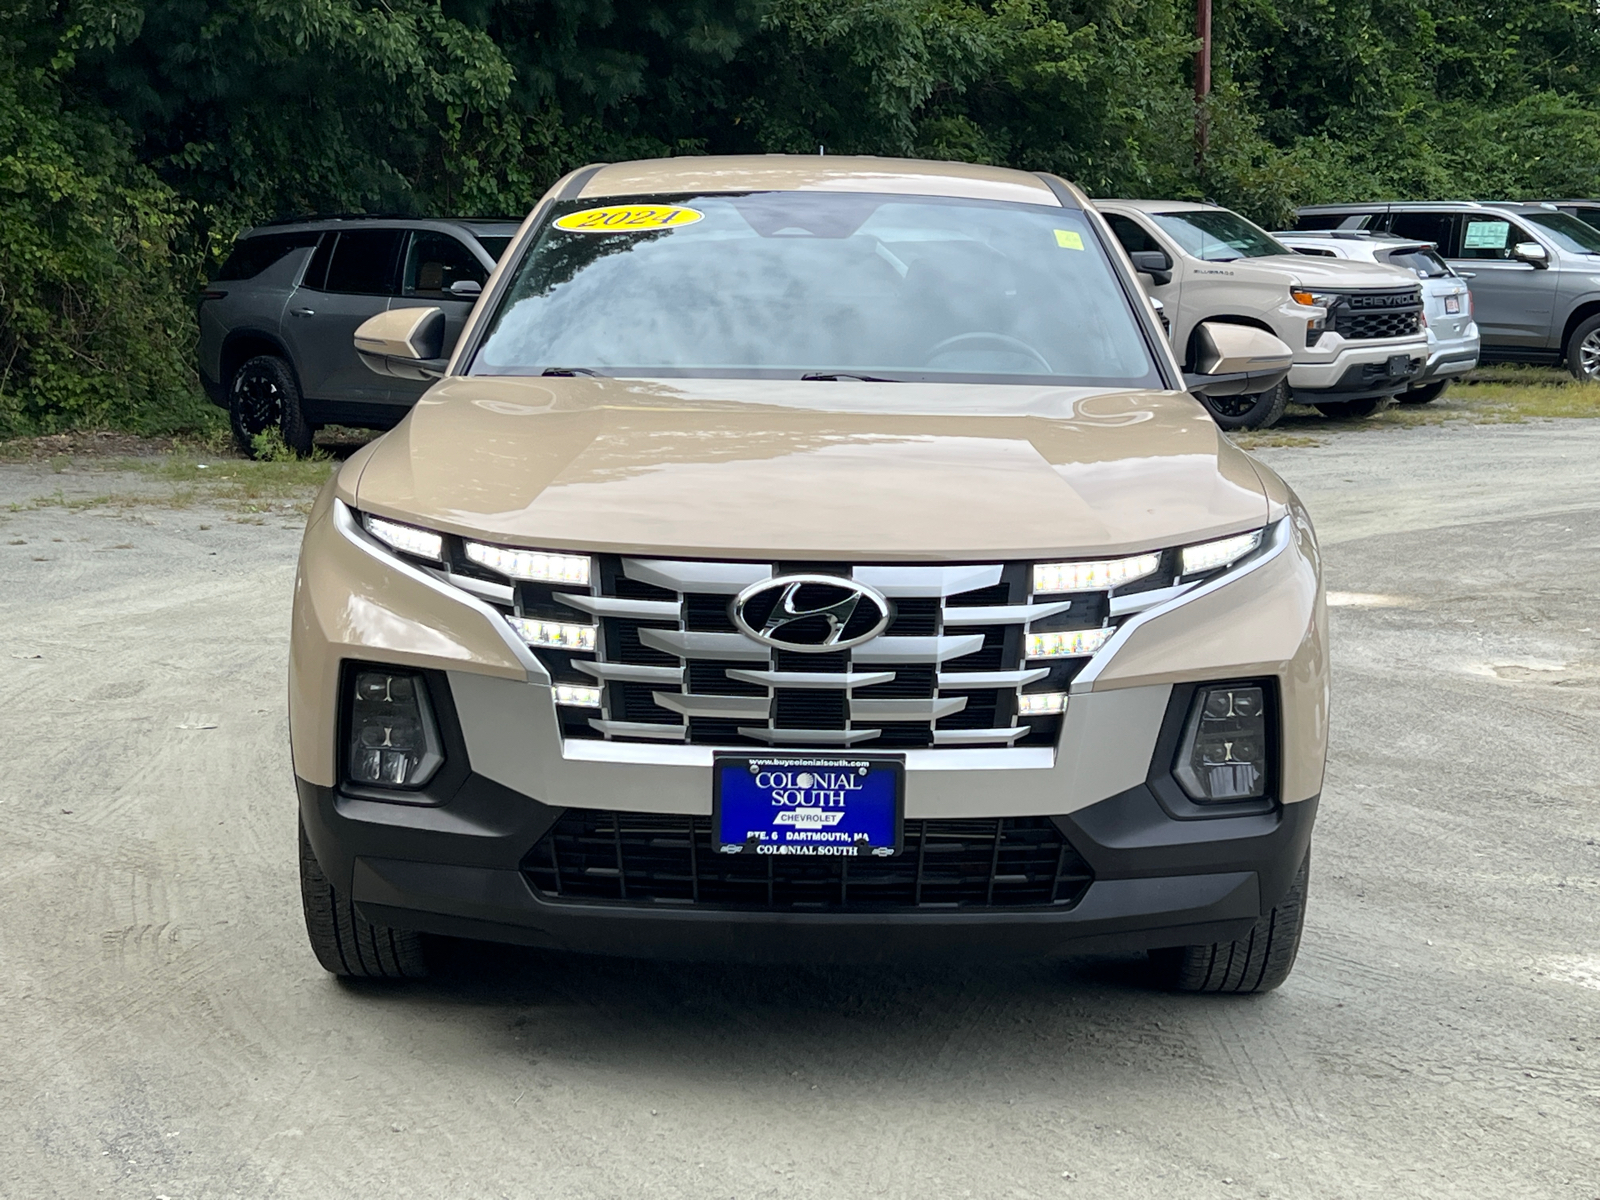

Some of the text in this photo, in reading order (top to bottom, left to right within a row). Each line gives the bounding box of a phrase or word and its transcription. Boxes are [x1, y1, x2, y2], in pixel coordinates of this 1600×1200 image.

[576, 210, 681, 227] 2024
[1351, 294, 1418, 307] CHEVROL
[749, 759, 869, 767] www.buycolonialsouth.com
[755, 772, 863, 790] COLONIAL
[771, 789, 846, 806] SOUTH
[780, 813, 837, 822] CHEVROLET
[771, 831, 778, 840] 6
[786, 832, 851, 843] DARTMOUTH,
[853, 833, 869, 842] MA
[756, 845, 858, 856] COLONIAL SOUTH
